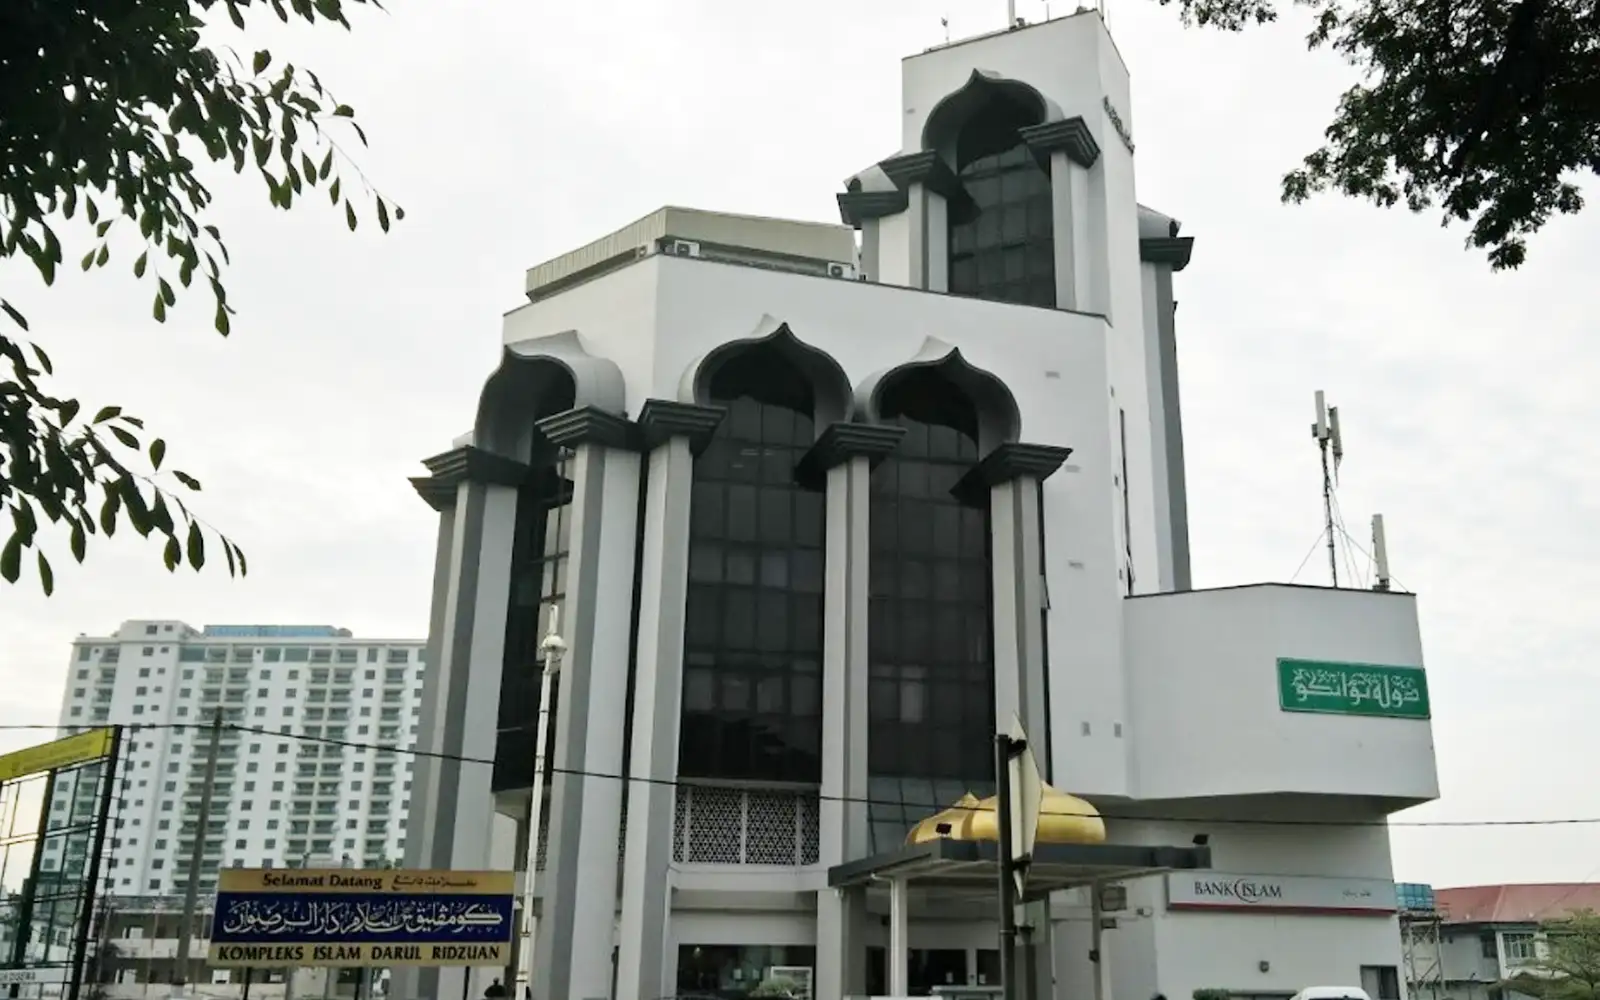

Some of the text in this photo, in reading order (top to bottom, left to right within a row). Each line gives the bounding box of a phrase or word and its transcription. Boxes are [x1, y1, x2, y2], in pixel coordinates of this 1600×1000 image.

[262, 872, 383, 890] Selamat Datang
[1194, 881, 1282, 899] BANK ISLAM
[218, 945, 500, 961] KOMPLEKS ISLAM DARUL RIDZUAN
